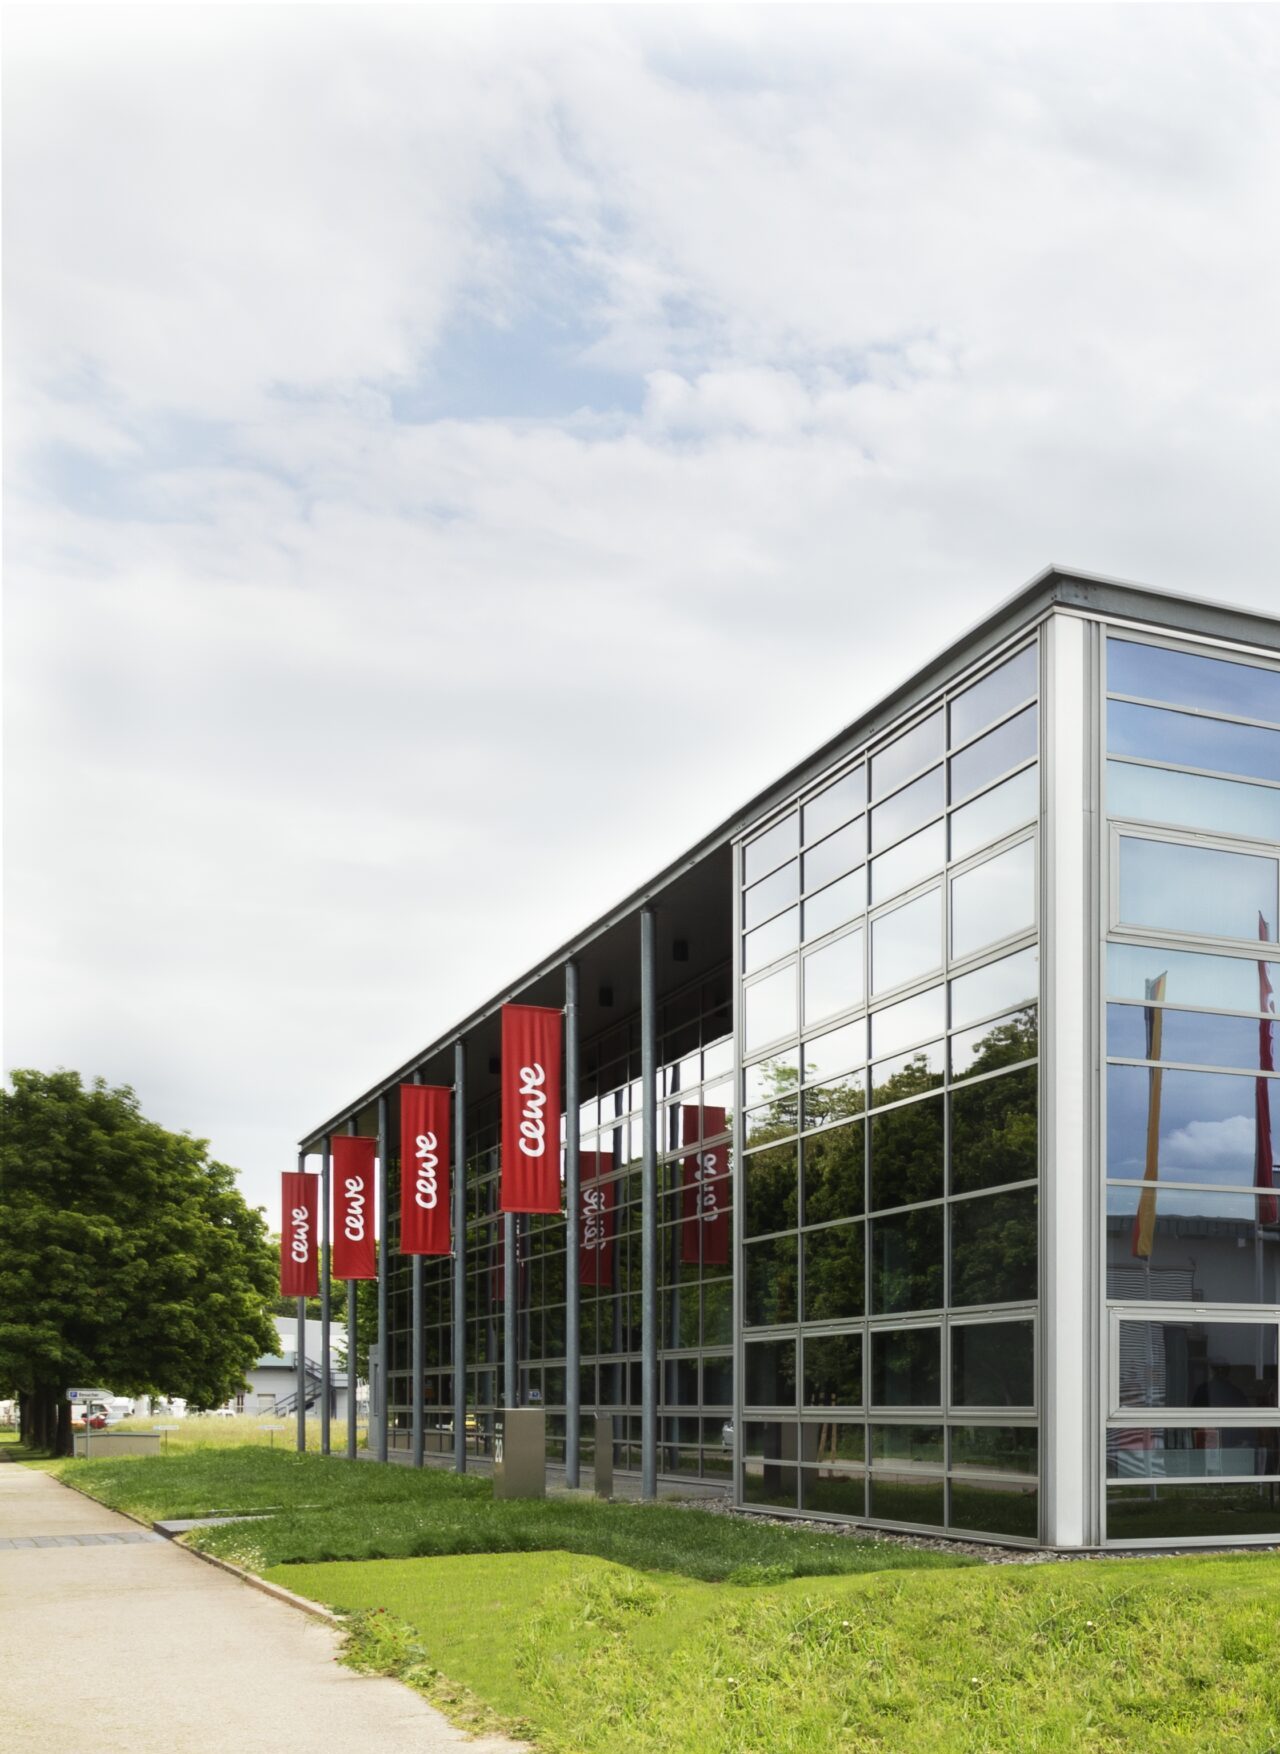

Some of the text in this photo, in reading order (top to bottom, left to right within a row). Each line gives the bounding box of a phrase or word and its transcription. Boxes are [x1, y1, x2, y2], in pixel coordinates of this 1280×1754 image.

[518, 1062, 547, 1158] cewe
[415, 1131, 439, 1210] cewe
[291, 1205, 310, 1264] cewe
[344, 1175, 366, 1242] cewe
